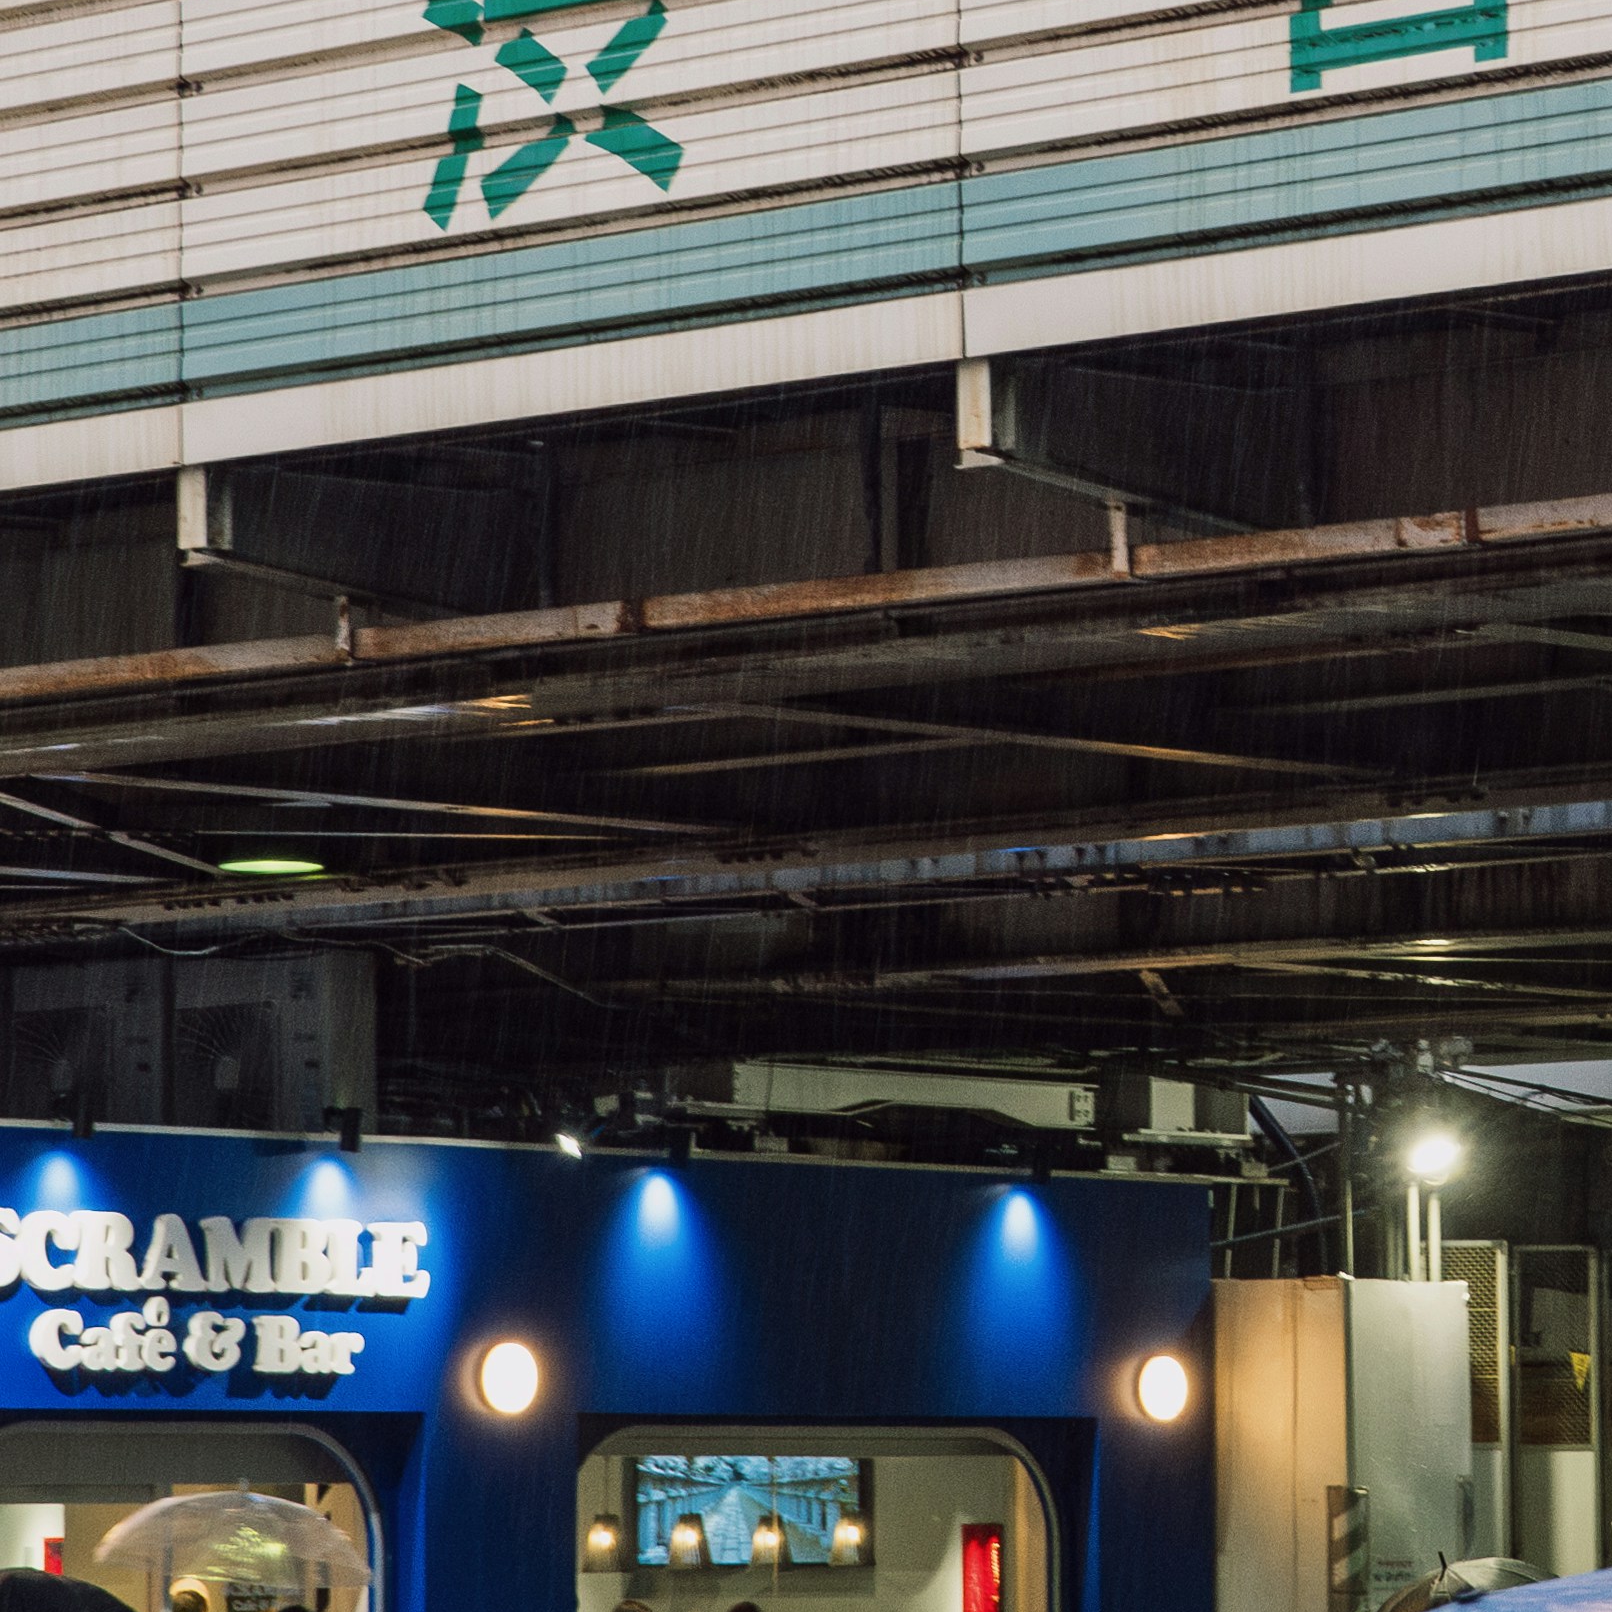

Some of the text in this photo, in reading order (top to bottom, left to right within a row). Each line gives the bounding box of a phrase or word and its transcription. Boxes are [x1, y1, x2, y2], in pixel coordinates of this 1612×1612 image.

[29, 1296, 366, 1375] Café & Bar
